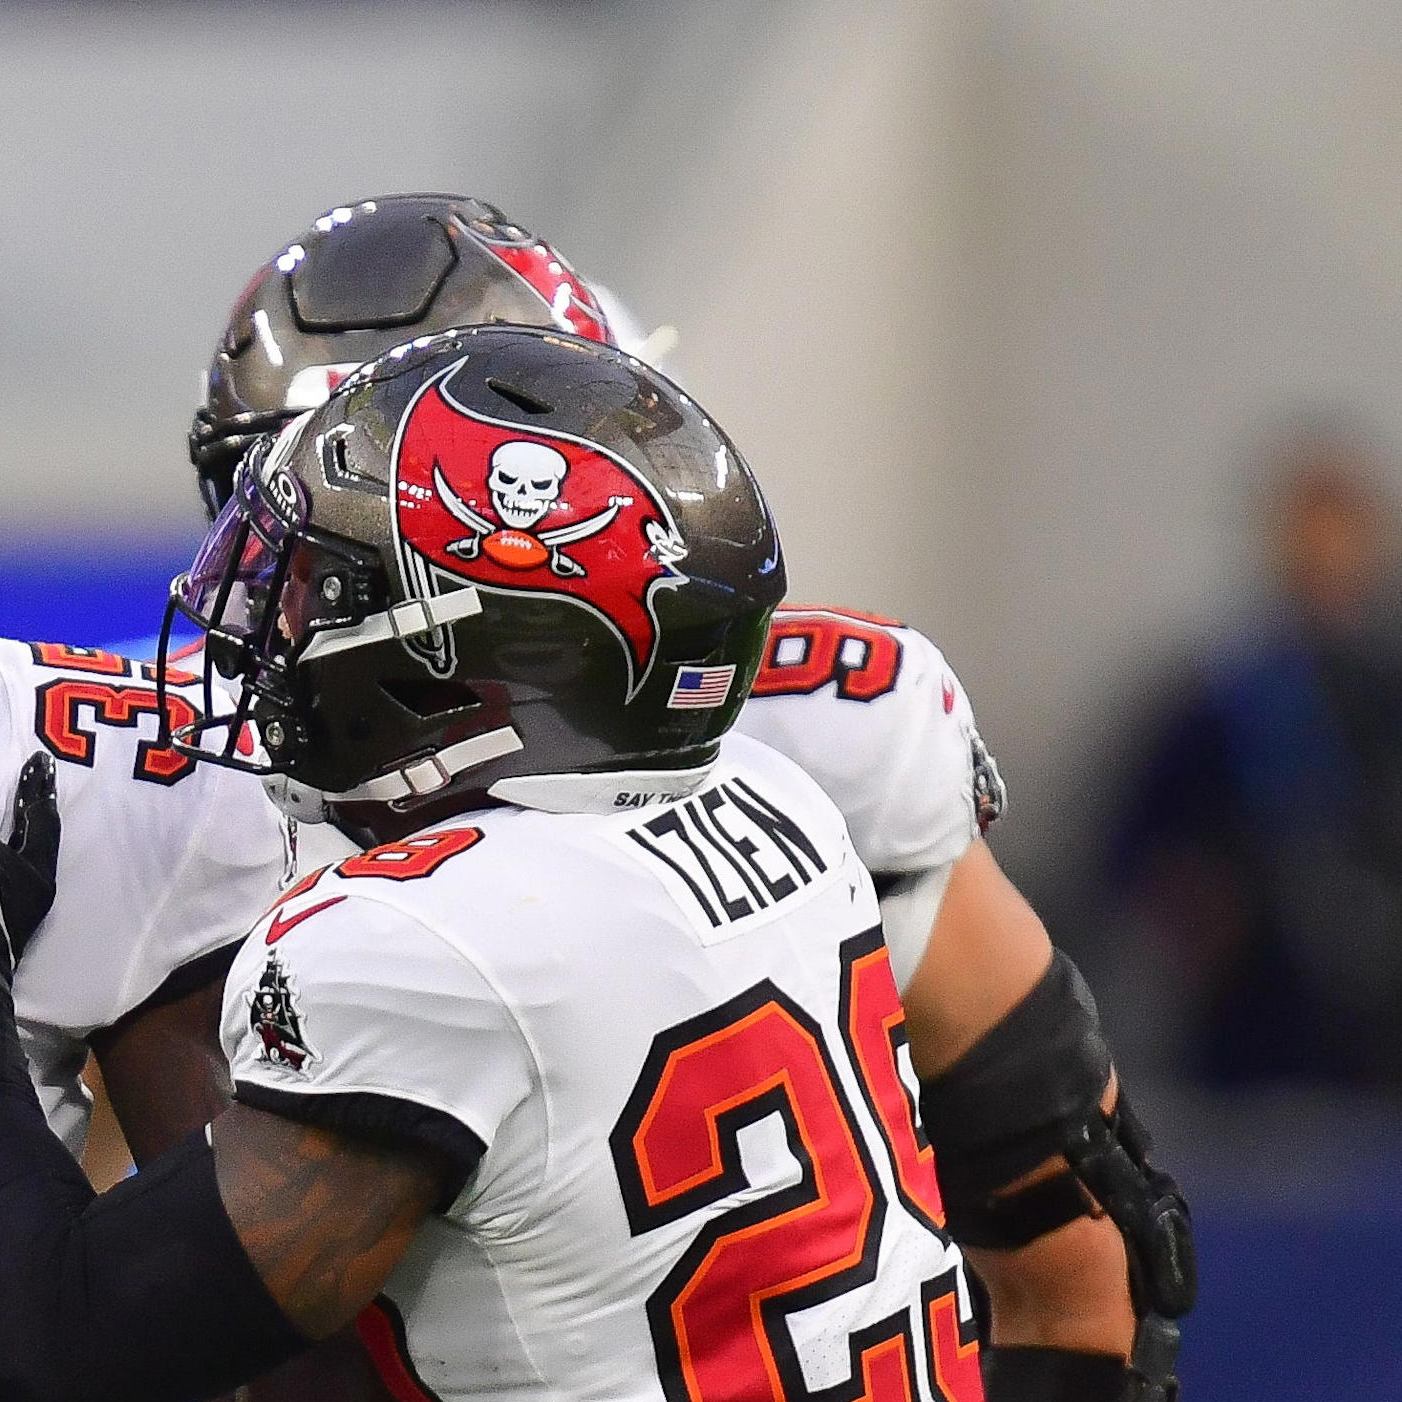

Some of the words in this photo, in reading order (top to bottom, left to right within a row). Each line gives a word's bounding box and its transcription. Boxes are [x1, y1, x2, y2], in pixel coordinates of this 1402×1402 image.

[613, 791, 655, 808] SAY
[658, 792, 693, 805] TH
[625, 776, 828, 928] IZIEN
